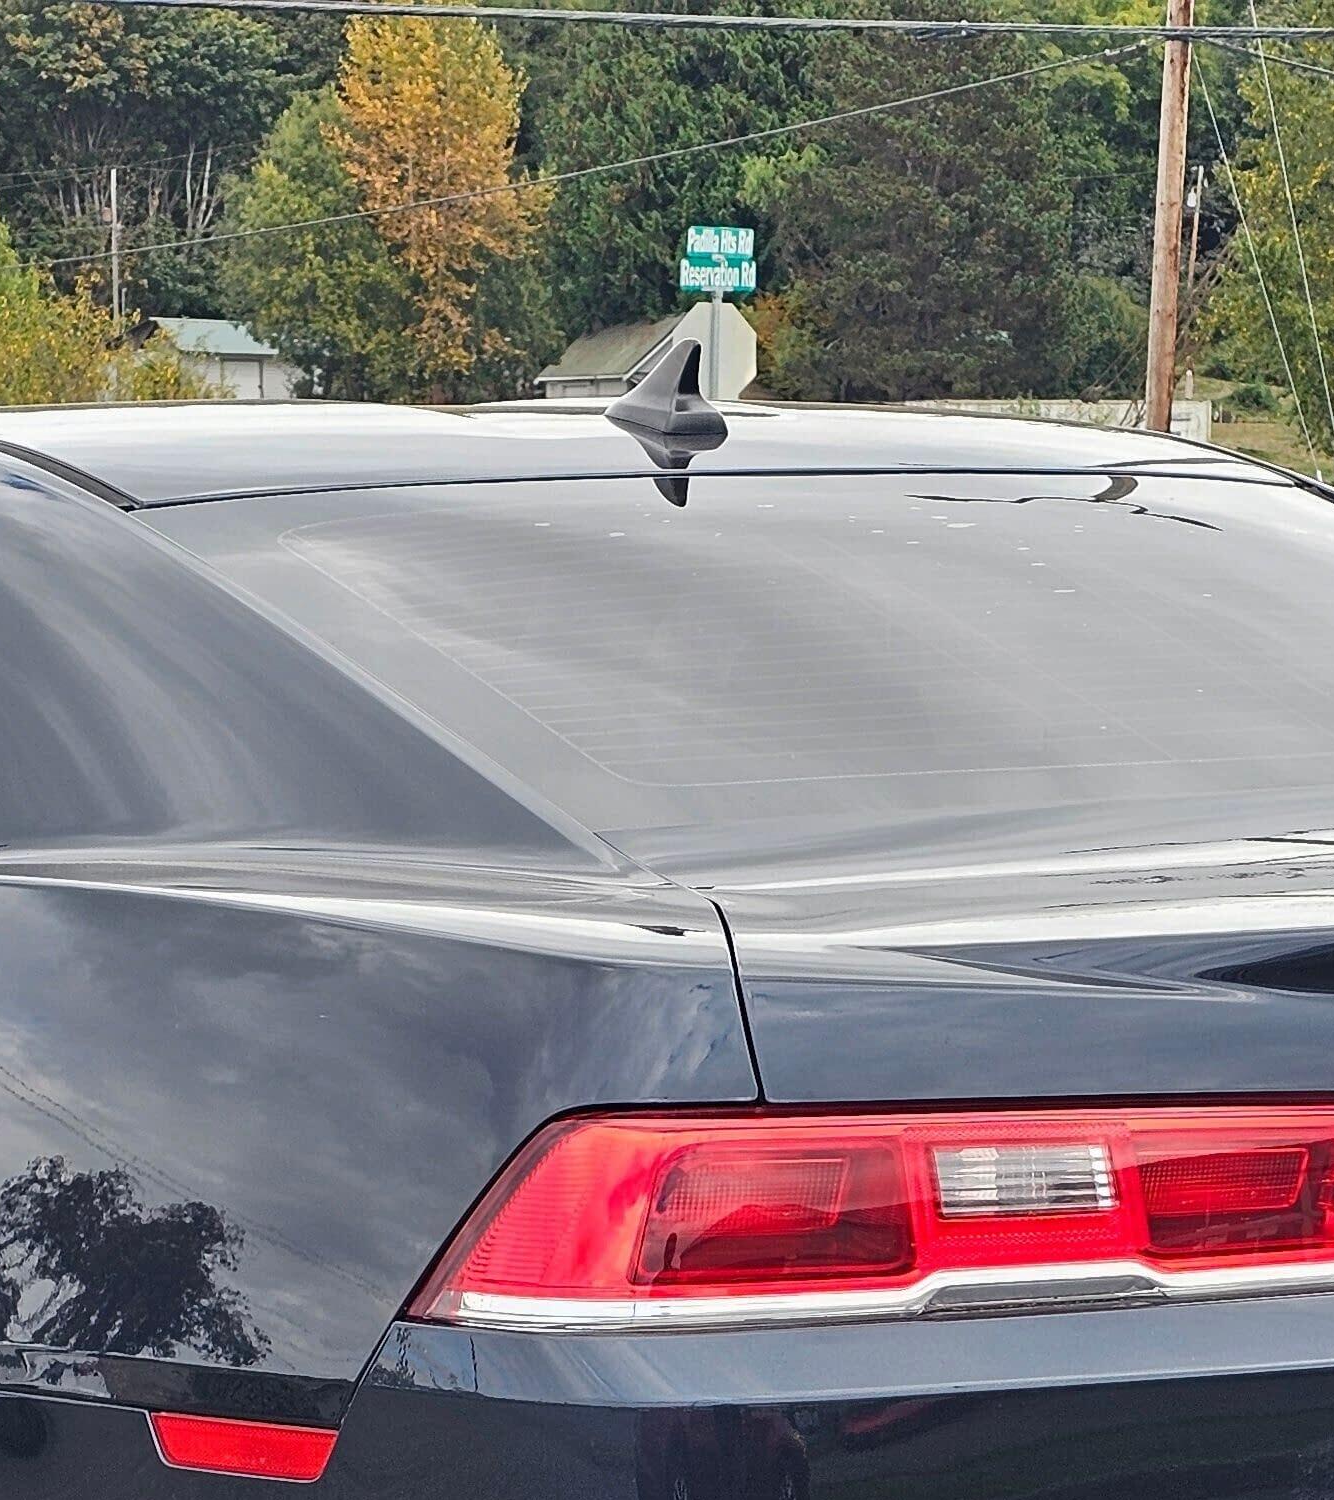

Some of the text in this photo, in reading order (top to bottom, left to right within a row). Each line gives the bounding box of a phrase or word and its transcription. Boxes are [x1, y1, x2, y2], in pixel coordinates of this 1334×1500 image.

[688, 229, 753, 254] Padilla Hts Rd
[681, 260, 755, 287] Reservation Rd
